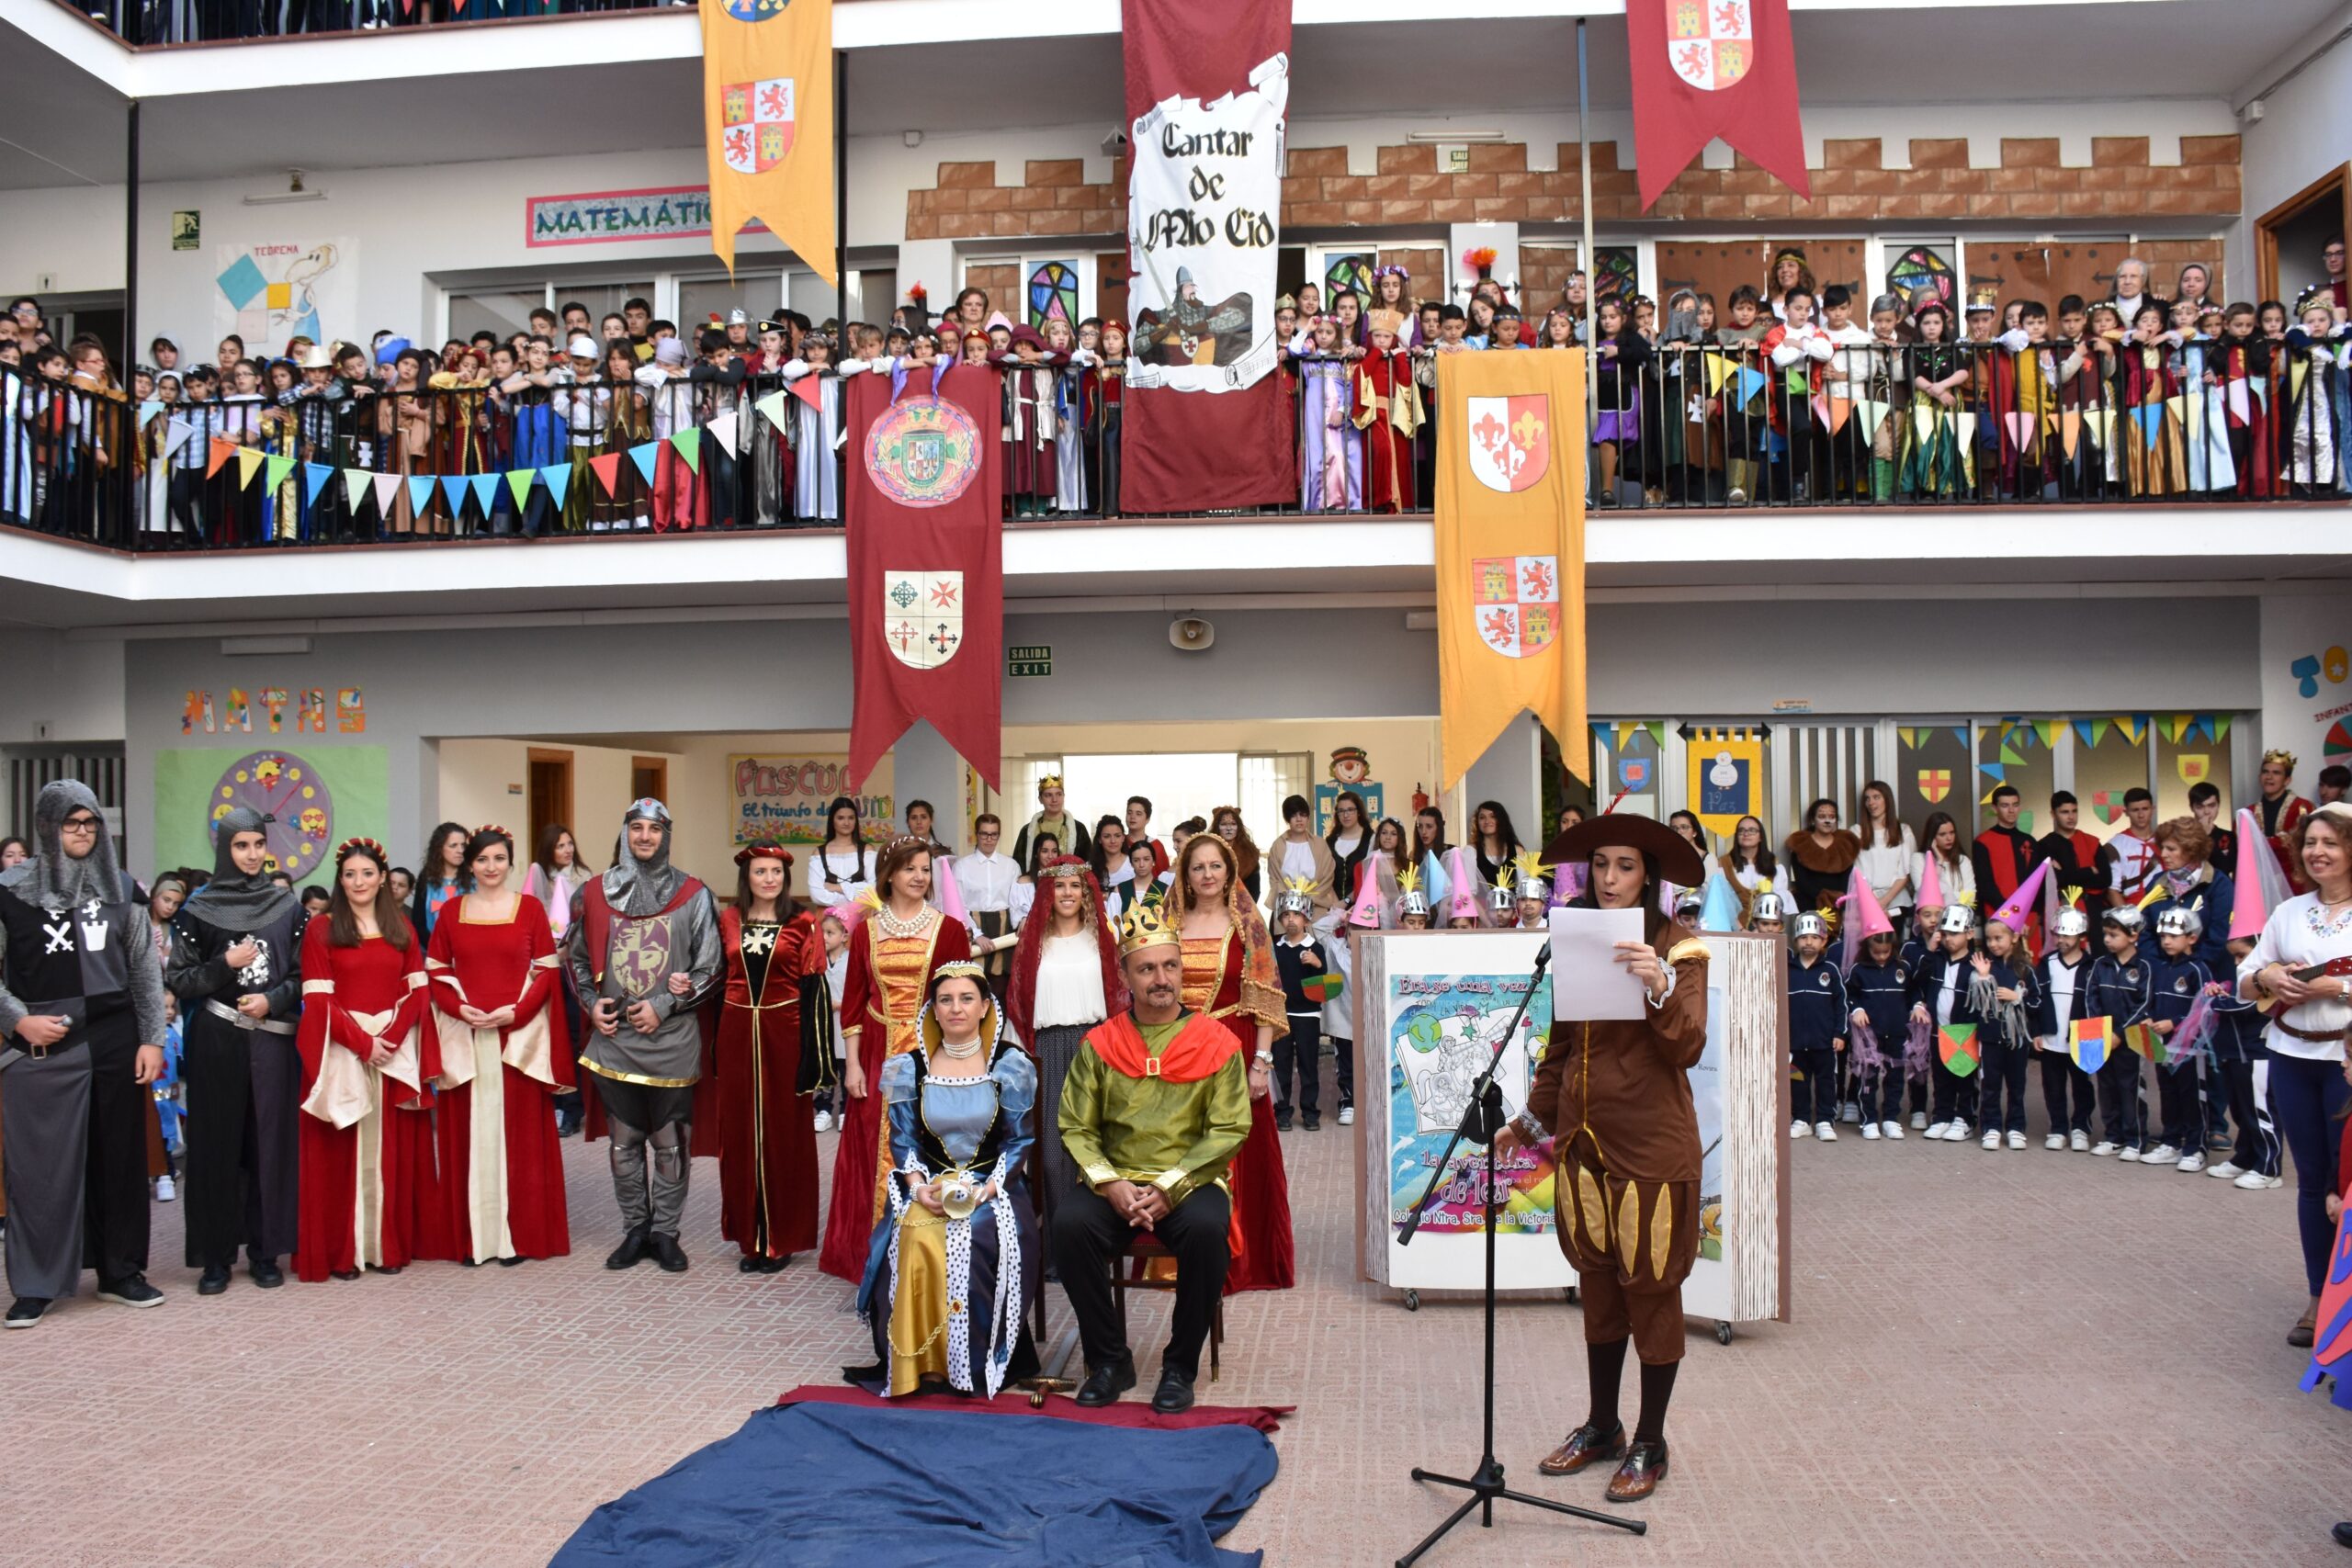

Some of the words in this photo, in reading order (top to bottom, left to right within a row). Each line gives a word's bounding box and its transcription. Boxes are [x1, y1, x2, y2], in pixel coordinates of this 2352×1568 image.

[1162, 122, 1254, 158] Cantar
[1189, 165, 1226, 202] de
[1145, 208, 1216, 253] Mio
[1225, 207, 1275, 248] Cid
[1012, 649, 1048, 659] SALIDA
[1012, 664, 1049, 674] EXIT
[182, 687, 366, 735] MATHS
[742, 802, 760, 818] El
[762, 801, 811, 818] triunfo
[1456, 981, 1493, 995] una
[1421, 1149, 1441, 1167] la
[1441, 1171, 1467, 1204] de
[1433, 1211, 1460, 1224] Ntra.
[1463, 1212, 1485, 1224] Sra.
[1505, 1210, 1516, 1224] la
